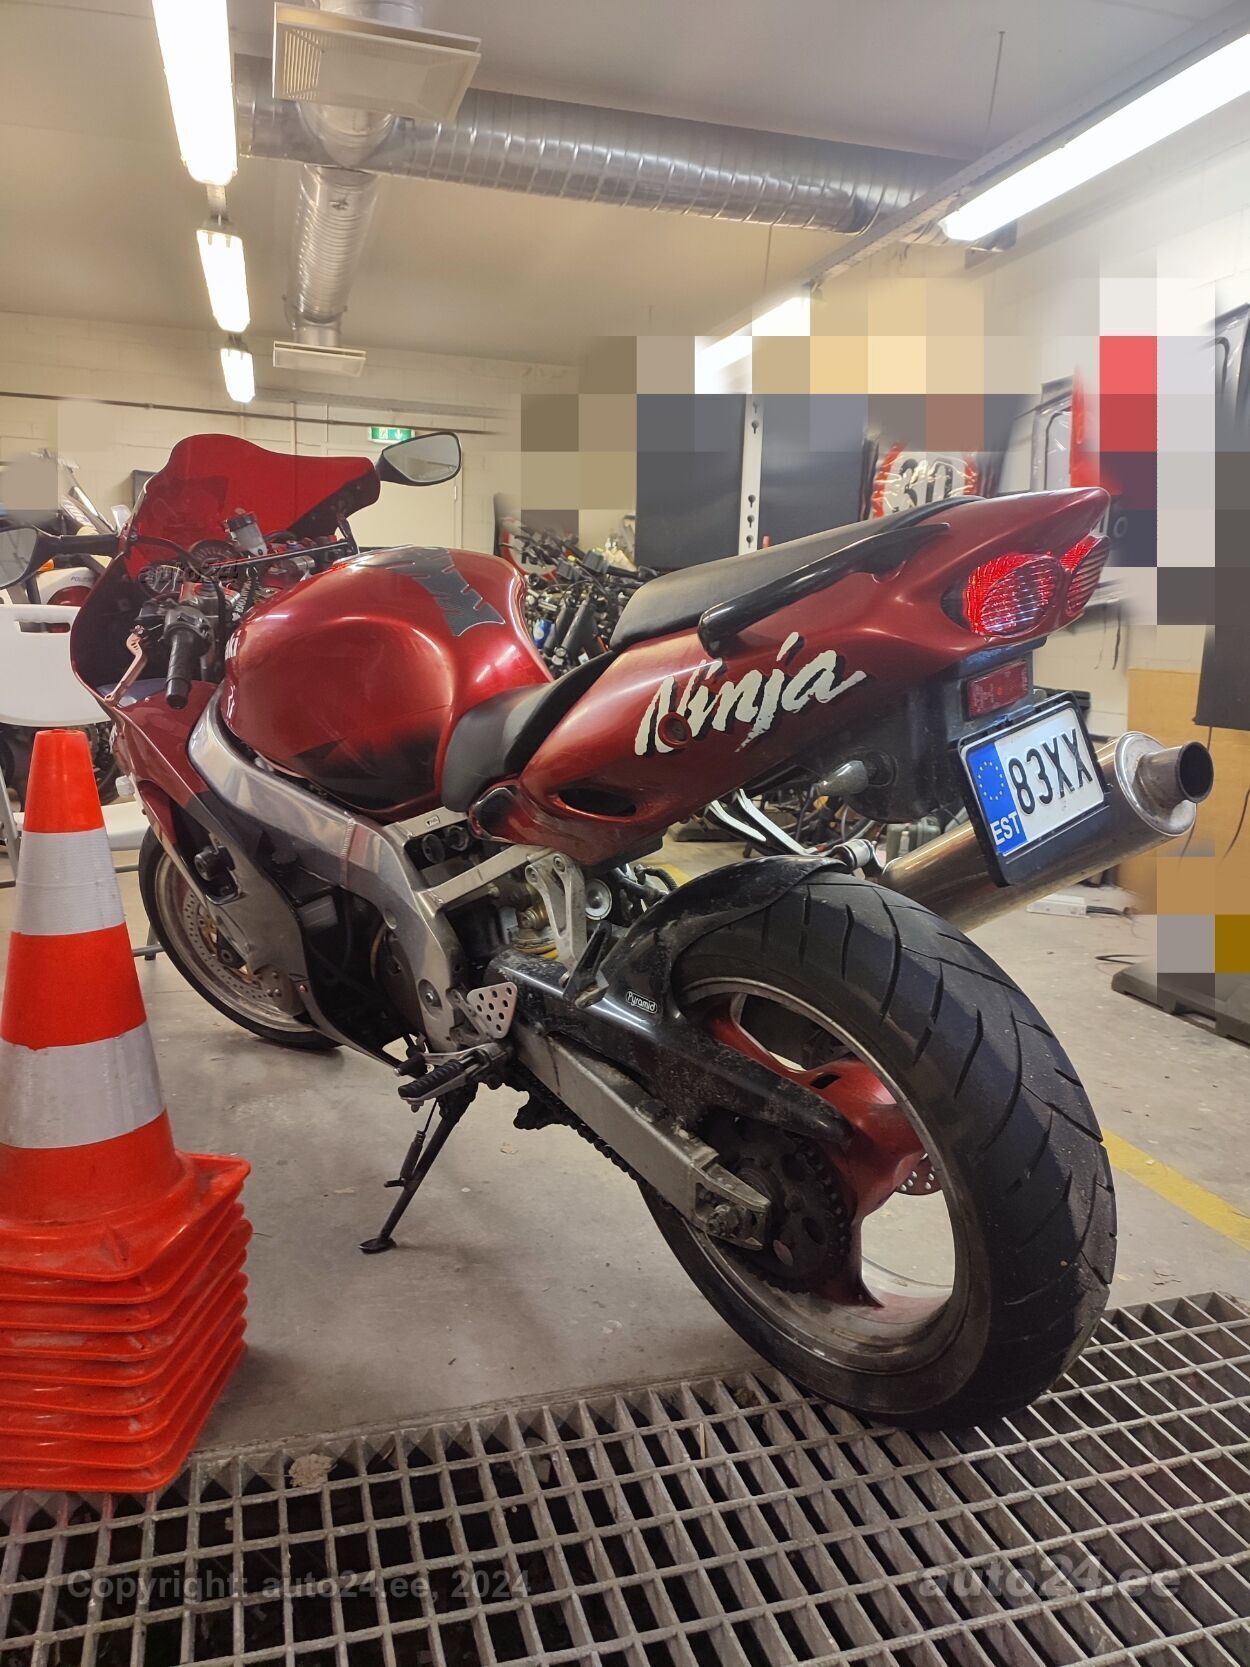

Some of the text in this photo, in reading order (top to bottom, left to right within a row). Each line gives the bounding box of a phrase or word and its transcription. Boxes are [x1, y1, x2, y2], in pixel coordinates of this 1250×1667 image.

[635, 632, 866, 755] Ninja
[1008, 728, 1093, 815] 83XX
[990, 811, 1020, 845] EST
[627, 991, 656, 1011] Pyramid
